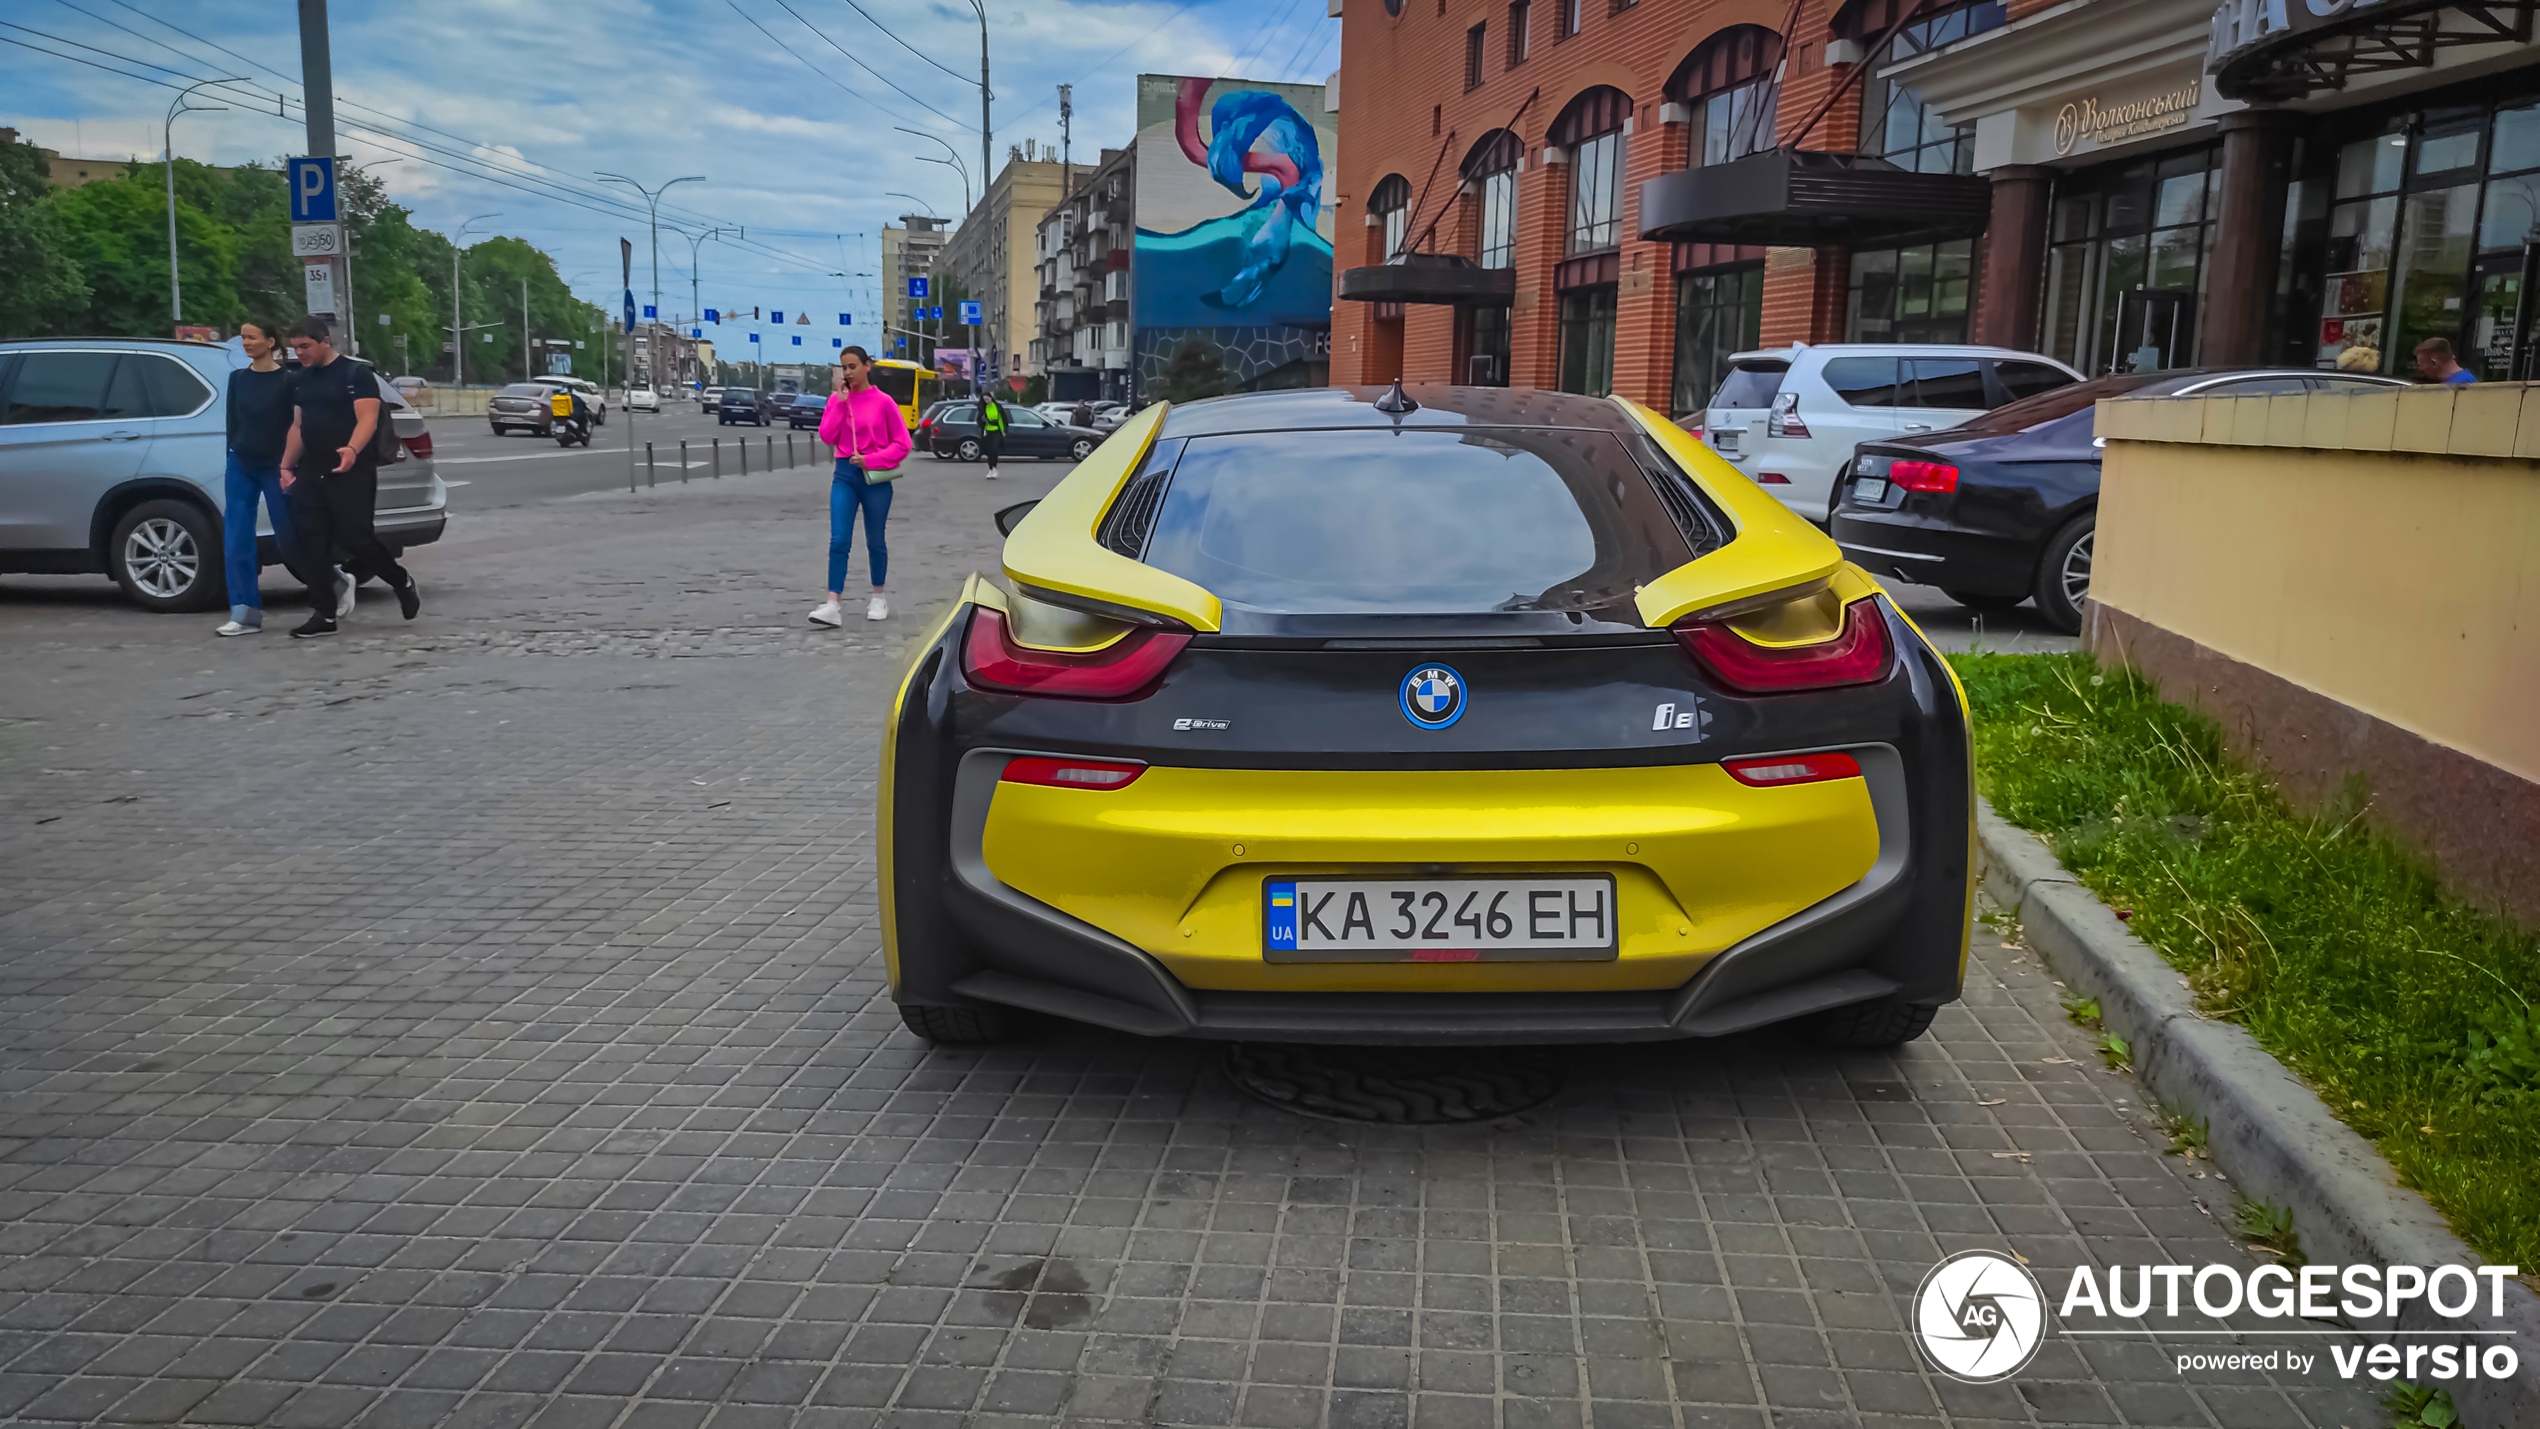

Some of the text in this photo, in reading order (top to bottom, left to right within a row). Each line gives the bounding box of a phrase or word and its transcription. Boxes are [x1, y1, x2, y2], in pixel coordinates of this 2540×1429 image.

[2081, 79, 2198, 139] Волконський
[300, 163, 325, 216] P
[320, 233, 333, 246] 50
[1411, 670, 1456, 688] BMW
[1300, 890, 1604, 941] KA 3246 EH
[1272, 925, 1294, 941] UA
